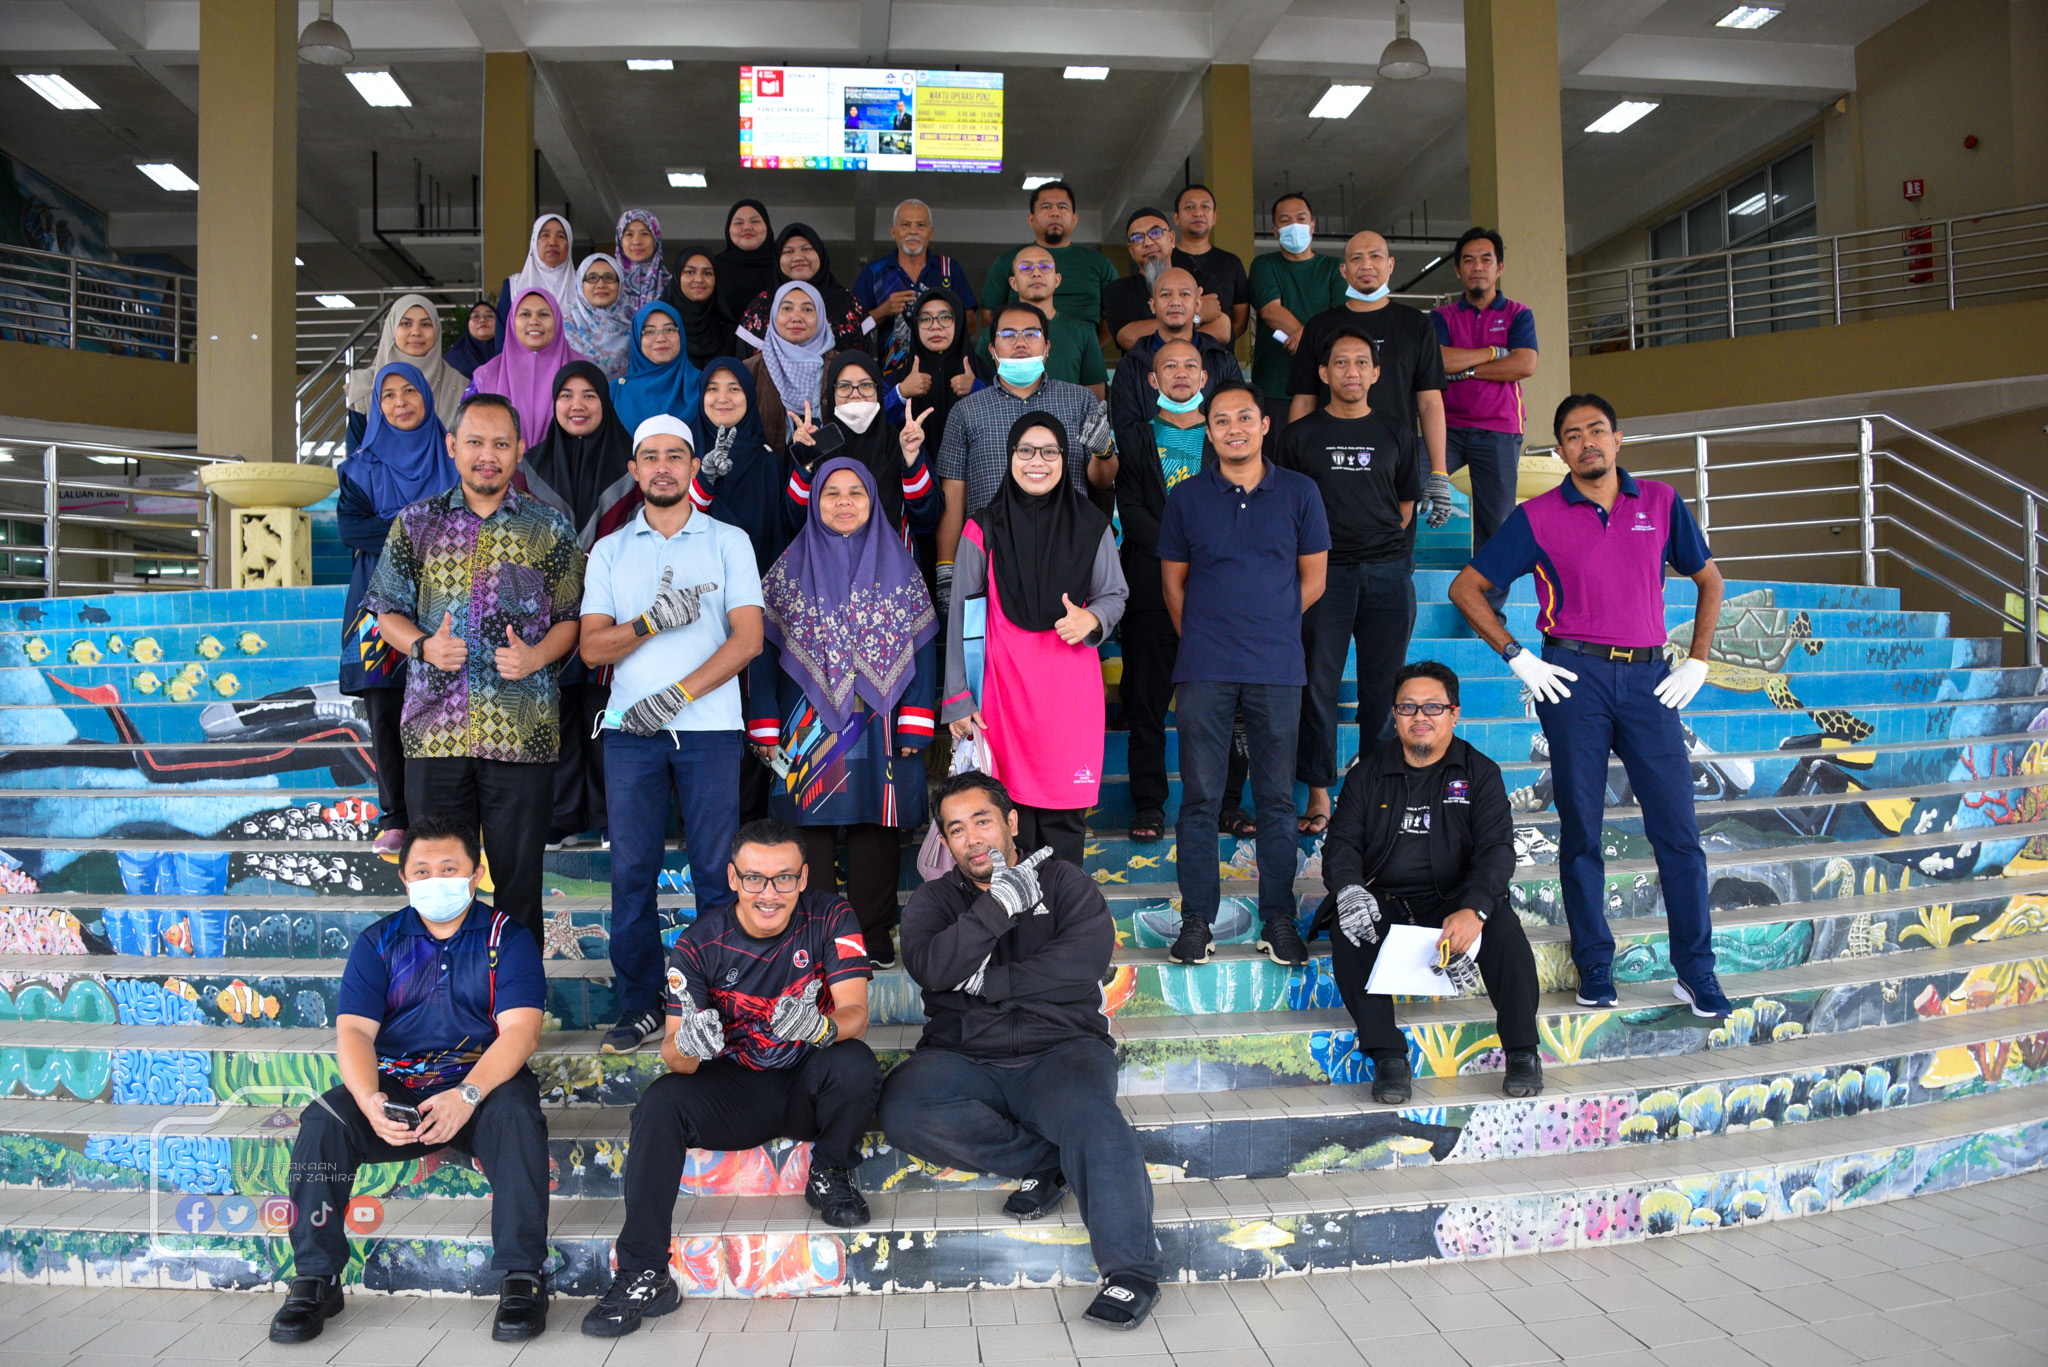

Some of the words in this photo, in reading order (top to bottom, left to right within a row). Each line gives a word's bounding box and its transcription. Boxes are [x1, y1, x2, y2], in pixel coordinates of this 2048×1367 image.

[929, 91, 949, 99] WAKTU
[950, 92, 974, 101] OPERASI
[976, 93, 991, 101] PSNZ
[59, 490, 94, 499] LALUAN
